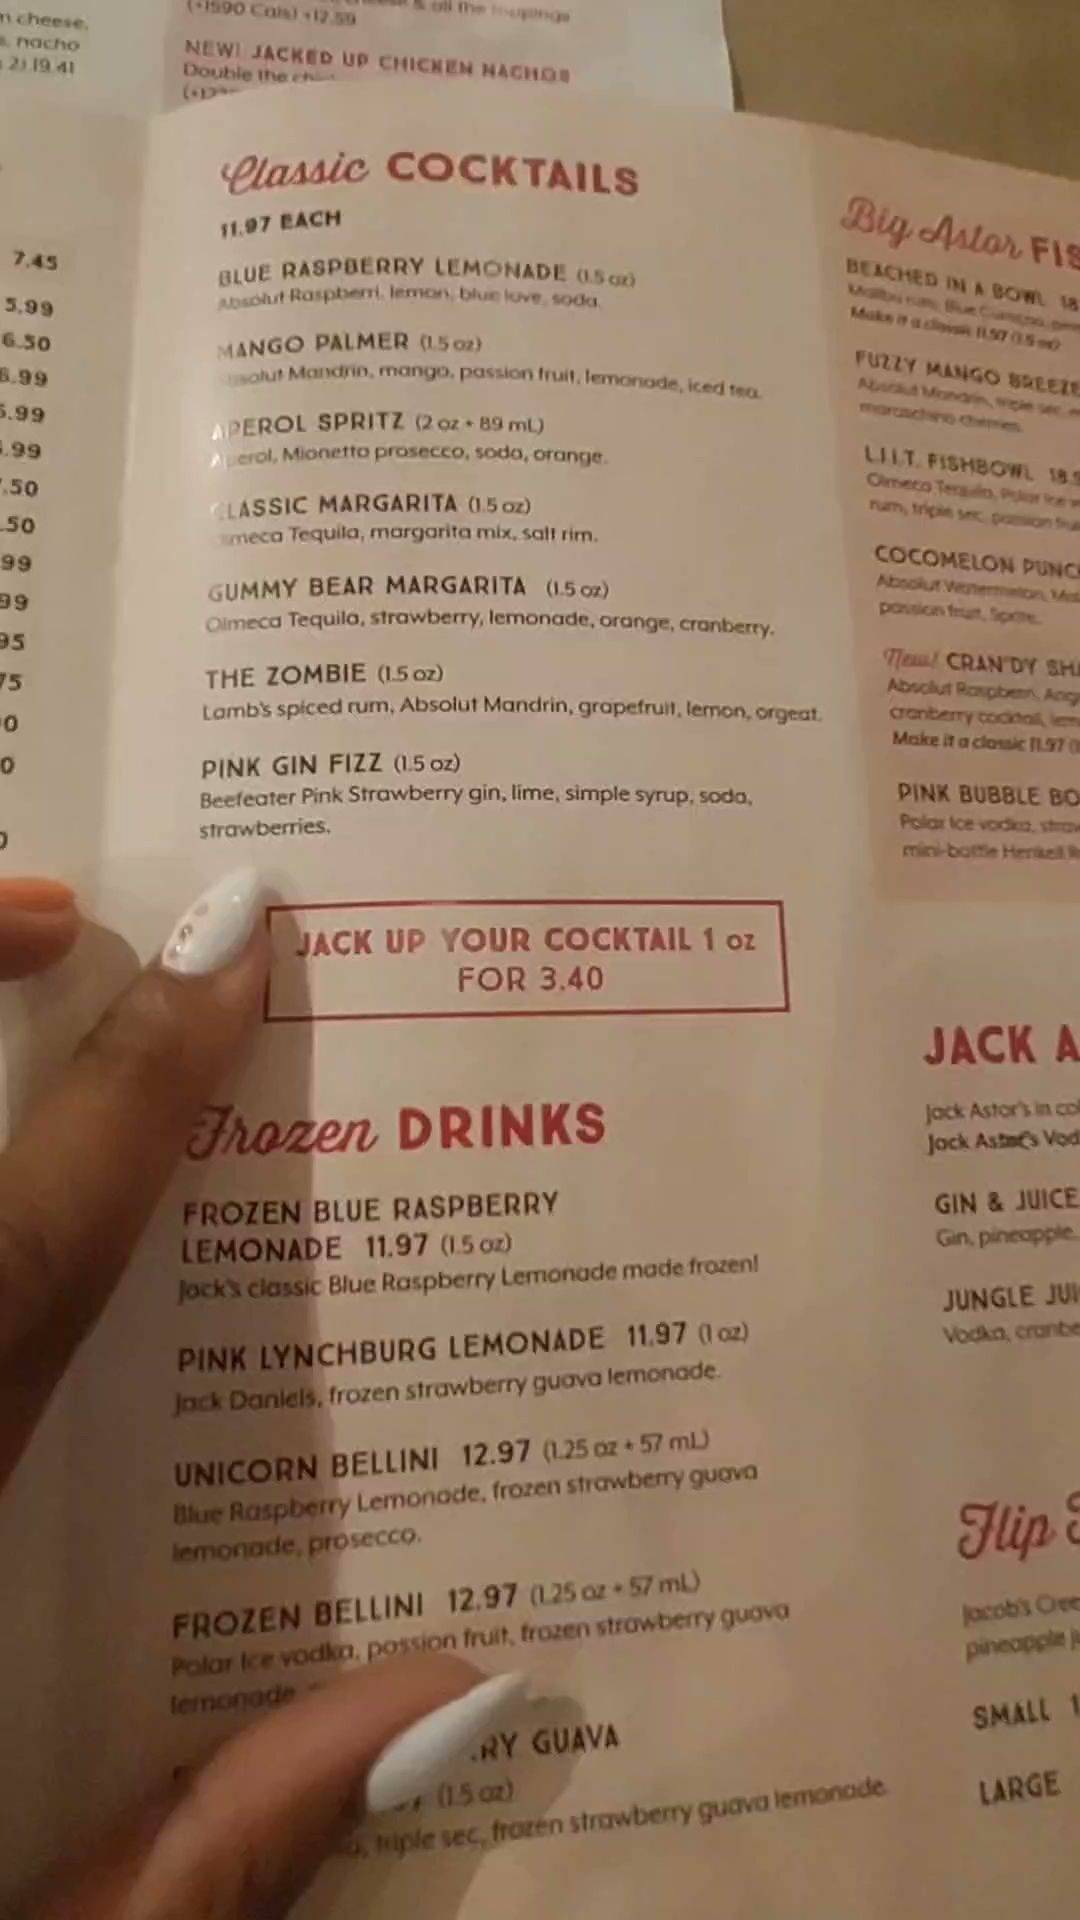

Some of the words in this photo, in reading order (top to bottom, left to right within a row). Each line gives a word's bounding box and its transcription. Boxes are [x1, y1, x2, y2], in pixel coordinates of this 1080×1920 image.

[17, 36, 80, 51] nacho
[183, 63, 251, 82] Double
[258, 69, 288, 82] the
[252, 44, 334, 66] JACKED
[342, 52, 369, 68] UP
[379, 54, 474, 77] CHICKEN
[481, 63, 571, 84] NACHOS
[221, 152, 369, 197] Classic
[387, 152, 639, 198] COCKTAILS
[221, 215, 270, 239] 11.97
[280, 209, 341, 230] EACH
[840, 196, 913, 249] Big
[918, 214, 1024, 260] Astor
[14, 250, 58, 271] 7.45
[219, 265, 271, 287] BLUE
[283, 257, 424, 280] RASPBERRY
[435, 257, 566, 281] LEMONADE
[846, 257, 938, 287] BEACHED
[946, 275, 966, 294] IN
[974, 281, 984, 296] A
[992, 282, 1046, 307] BOWL
[5, 297, 54, 317] 5.99
[1, 332, 51, 352] 6.50
[217, 335, 304, 360] MANGO
[315, 332, 409, 351] PALMER
[289, 364, 374, 382] Mandrin,
[379, 366, 454, 383] mango,
[460, 366, 533, 384] passion
[539, 367, 580, 385] fruit,
[585, 369, 682, 394] lemonade,
[688, 379, 724, 395] iced
[729, 384, 763, 400] tea.
[856, 350, 916, 374] FUZZY
[926, 361, 1001, 386] MANGO
[318, 412, 404, 431] SPRITZ
[283, 445, 370, 461] Mionetto
[375, 445, 469, 462] prosecco,
[476, 444, 529, 463] soda,
[534, 446, 607, 467] orange.
[927, 452, 1034, 481] FISHBOWL
[319, 494, 456, 513] MARGARITA
[289, 524, 364, 545] Tequila,
[370, 524, 470, 544] margarita
[477, 525, 517, 541] mix,
[522, 526, 555, 541] salt
[562, 527, 598, 543] rim.
[875, 545, 1014, 574] COCOMELON
[209, 578, 297, 602] GUMMY
[309, 576, 373, 596] BEAR
[386, 575, 526, 595] MARGARITA
[546, 578, 576, 597] (1.5
[580, 580, 609, 599] oz)
[205, 614, 281, 633] Olmeca
[289, 611, 364, 631] Tequila,
[370, 607, 483, 631] strawberry,
[489, 609, 594, 629] lemonade,
[600, 612, 674, 634] orange,
[680, 615, 775, 640] cranberry.
[205, 668, 255, 690] THE
[266, 663, 366, 686] ZOMBIE
[946, 653, 1036, 675] CRAN'DY
[203, 699, 271, 721] Lamb's
[277, 699, 342, 719] spiced
[348, 700, 394, 715] rum,
[400, 696, 476, 713] Absolut
[484, 696, 573, 715] Mandrin,
[579, 697, 681, 718] grapefruit,
[687, 701, 752, 721] lemon,
[755, 706, 822, 725] orgeat.
[889, 706, 973, 727] cranberry
[892, 731, 939, 747] Make
[943, 734, 954, 747] it
[958, 738, 969, 748] a
[202, 757, 260, 779] PINK
[272, 754, 316, 776] GIN
[329, 753, 383, 774] FIZZ
[394, 755, 424, 773] (1.5
[430, 753, 460, 773] oz)
[200, 791, 295, 810] Beefeater
[302, 787, 343, 805] Pink
[349, 785, 463, 807] Strawberry
[469, 787, 507, 806] gin,
[512, 784, 559, 802] lime,
[565, 786, 629, 806] simple
[635, 791, 693, 807] syrup,
[699, 789, 752, 807] soda,
[898, 783, 949, 802] PINK
[959, 784, 1040, 805] BUBBLE
[199, 819, 330, 839] strawberries.
[295, 930, 371, 957] JACK
[387, 929, 425, 953] UP
[441, 927, 530, 952] YOUR
[545, 927, 690, 952] COCKTAIL
[704, 927, 715, 951] 1
[726, 931, 756, 951] oz
[459, 967, 526, 992] FOR
[540, 966, 604, 991] 3.40
[924, 1024, 1036, 1065] JACK
[926, 1102, 964, 1125] Jack
[970, 1100, 1031, 1120] Astor's
[187, 1105, 379, 1162] Frozen
[400, 1103, 605, 1151] DRINKS
[184, 1201, 300, 1226] FROZEN
[314, 1199, 380, 1223] BLUE
[394, 1191, 558, 1220] RASPBERRY
[934, 1192, 977, 1216] GIN
[987, 1191, 1003, 1213] &
[1015, 1187, 1080, 1211] JUICE
[182, 1236, 341, 1264] LEMONADE
[367, 1232, 428, 1257] 11.97
[247, 1277, 321, 1298] classic
[329, 1275, 376, 1295] Blue
[382, 1270, 495, 1295] Raspberry
[502, 1262, 617, 1287] Lemonade
[622, 1257, 684, 1280] made
[689, 1254, 759, 1275] frozen!
[943, 1285, 1036, 1313] JUNGLE
[178, 1347, 247, 1372] PINK
[260, 1336, 436, 1370] LYNCHBURG
[450, 1326, 605, 1359] LEMONADE
[627, 1321, 687, 1348] 11.97
[175, 1392, 221, 1417] Jack
[230, 1387, 323, 1411] Daniels,
[330, 1384, 399, 1405] frozen
[406, 1376, 527, 1400] strawberry
[533, 1370, 602, 1396] guava
[608, 1360, 720, 1386] lemonade.
[175, 1454, 317, 1488] UNICORN
[332, 1447, 437, 1478] BELLINI
[464, 1438, 530, 1468] 12.97
[958, 1501, 1057, 1562] Flip
[173, 1605, 300, 1641] FROZEN
[315, 1592, 423, 1626] BELLINI
[449, 1583, 517, 1613] 12.97
[963, 1598, 1031, 1628] Jacob's
[966, 1629, 1065, 1665] pineapple
[973, 1697, 1051, 1730] SMALL
[532, 1725, 621, 1755] GUAVA
[980, 1770, 1060, 1806] LARGE
[376, 1828, 435, 1857] triple
[492, 1816, 563, 1844] frozen
[570, 1804, 691, 1836] strawberry
[698, 1794, 770, 1826] guava
[773, 1776, 887, 1812] lemonade.
